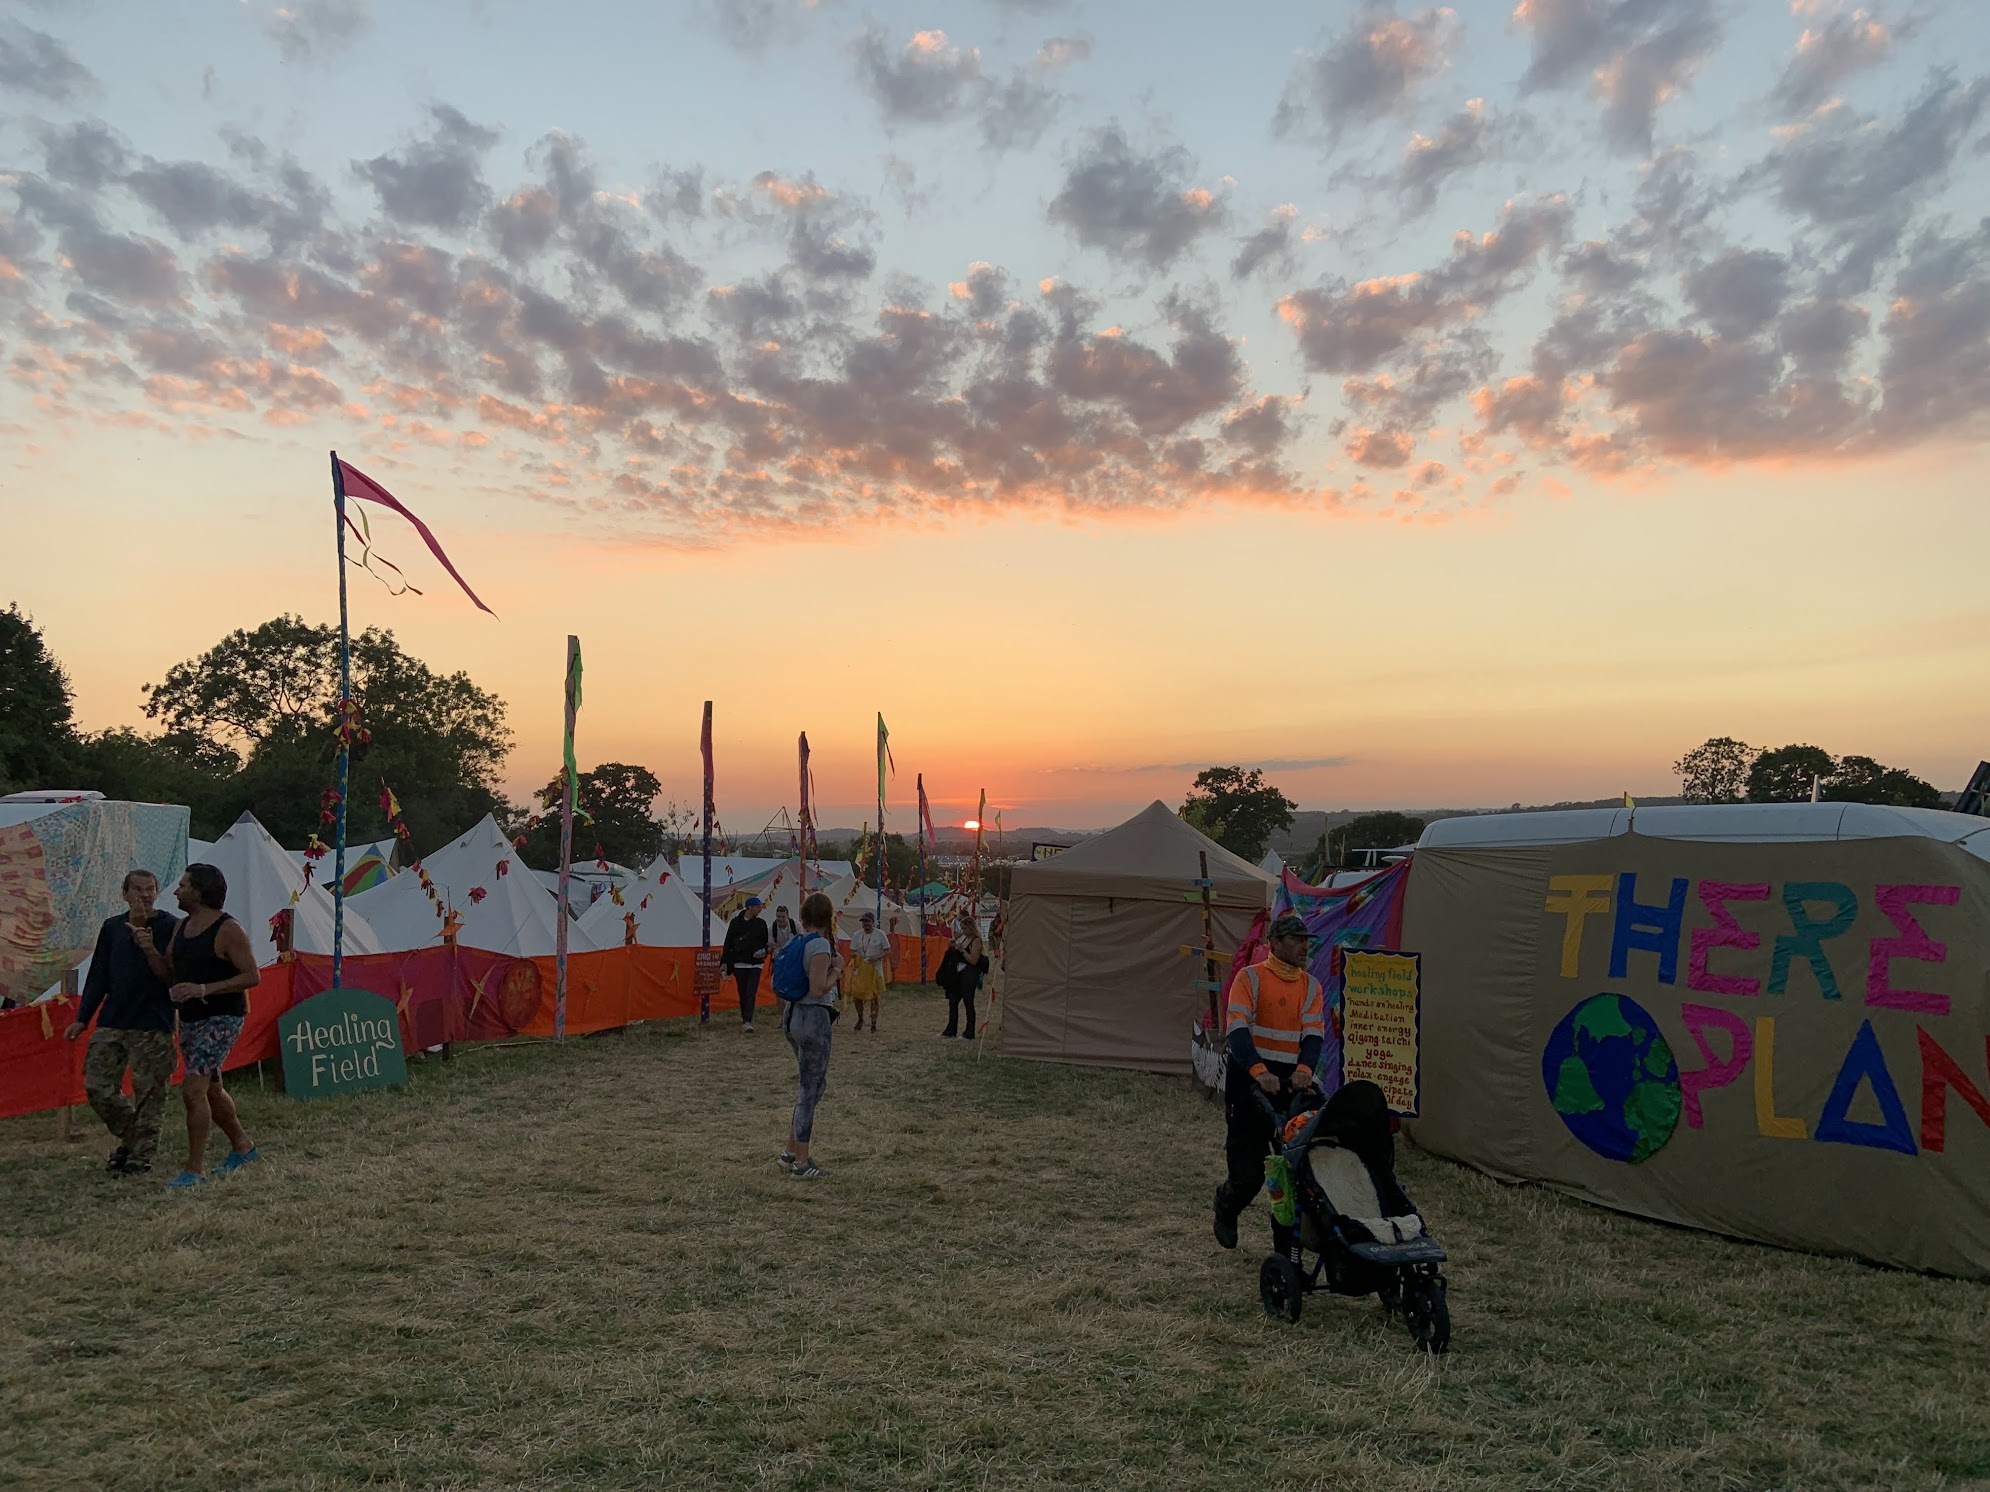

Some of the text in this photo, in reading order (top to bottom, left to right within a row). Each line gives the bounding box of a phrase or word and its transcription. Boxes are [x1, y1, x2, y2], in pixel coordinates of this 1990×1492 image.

[1545, 872, 1961, 1016] THERE
[1350, 964, 1413, 981] healing field
[1347, 983, 1413, 998] workshops
[1347, 997, 1414, 1014] hands on healing
[1349, 1009, 1405, 1023] Meditation
[286, 1011, 396, 1053] Healing
[1350, 1020, 1411, 1037] inner energy
[1365, 1048, 1393, 1060] yoga
[312, 1045, 381, 1087] Field
[1347, 1067, 1410, 1086] relax engage
[1680, 1002, 1990, 1156] PLAN
[1396, 1096, 1412, 1110] day
